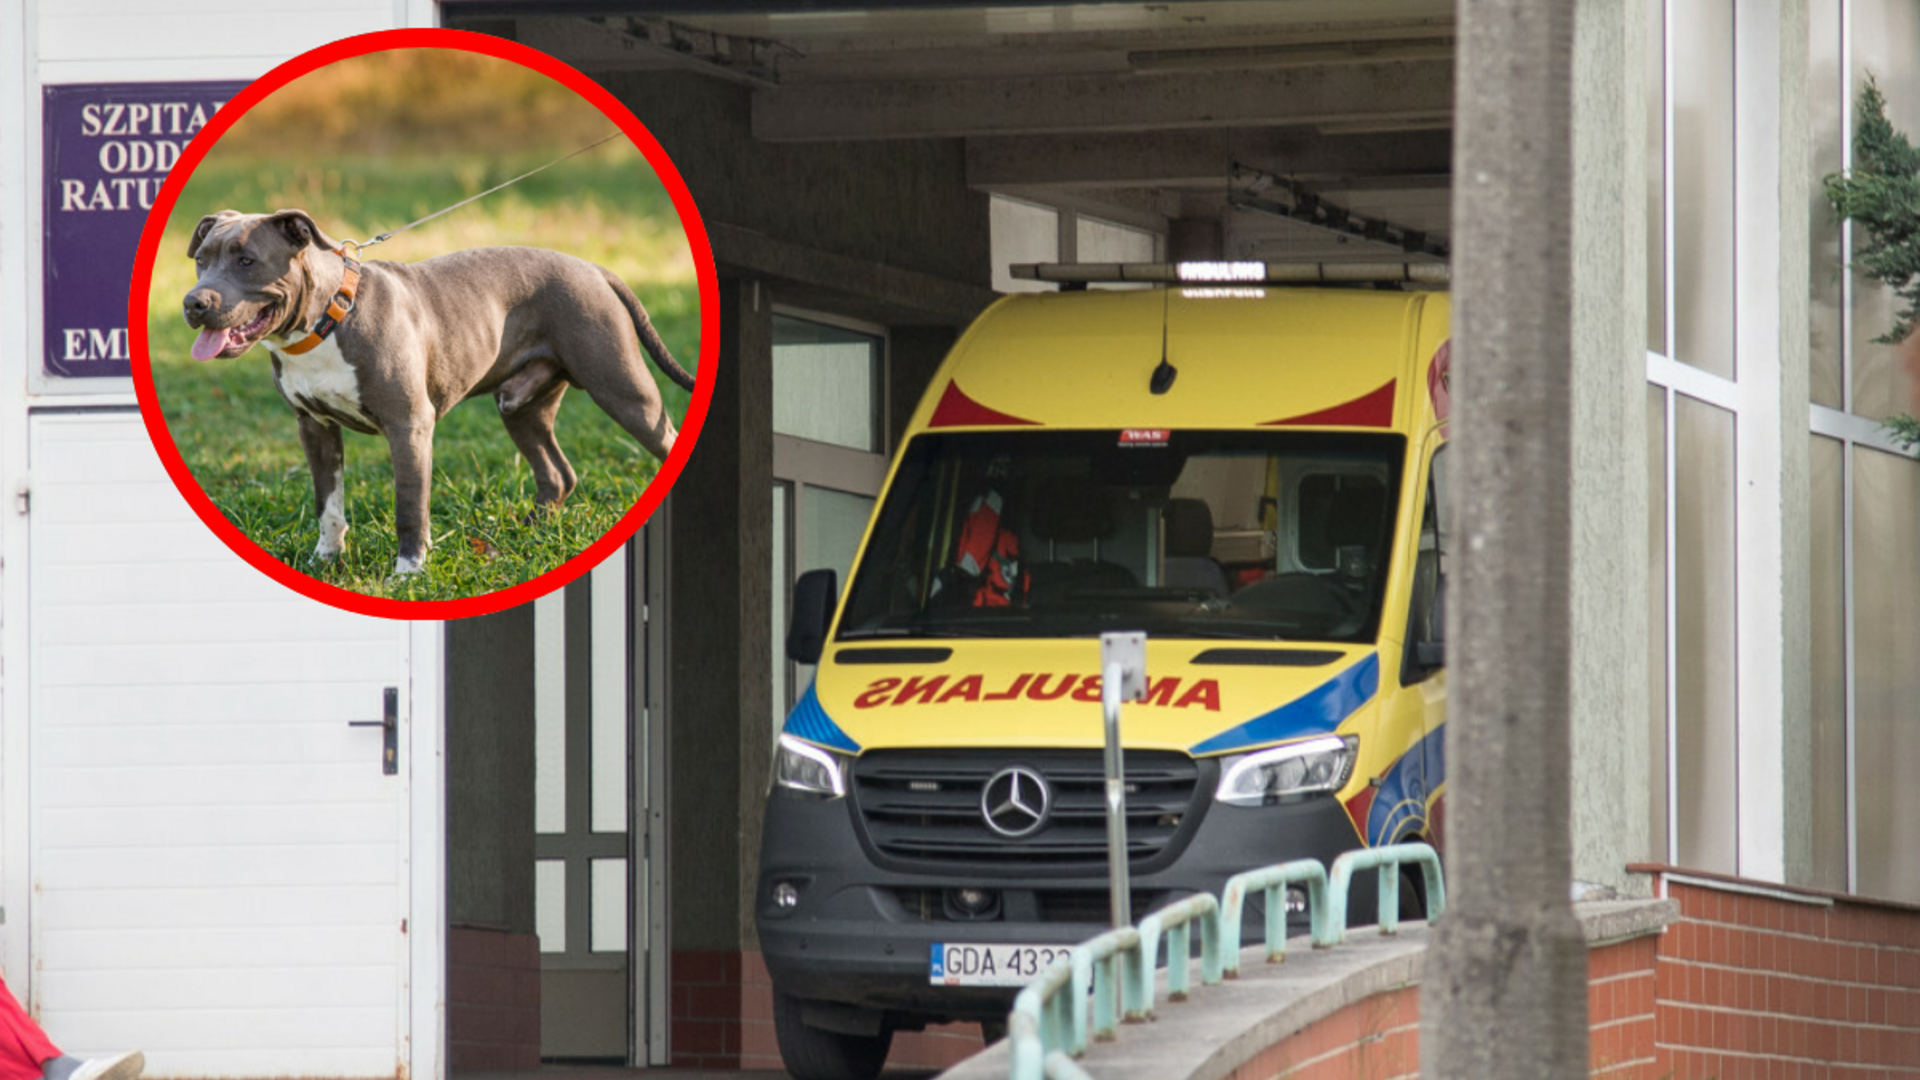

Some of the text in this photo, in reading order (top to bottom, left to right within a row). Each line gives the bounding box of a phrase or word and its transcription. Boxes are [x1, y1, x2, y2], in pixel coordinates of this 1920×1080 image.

[81, 102, 227, 136] SZPITA
[99, 140, 193, 173] ODD
[62, 328, 131, 360] EM
[1128, 430, 1162, 440] WAS
[946, 947, 996, 976] GDA
